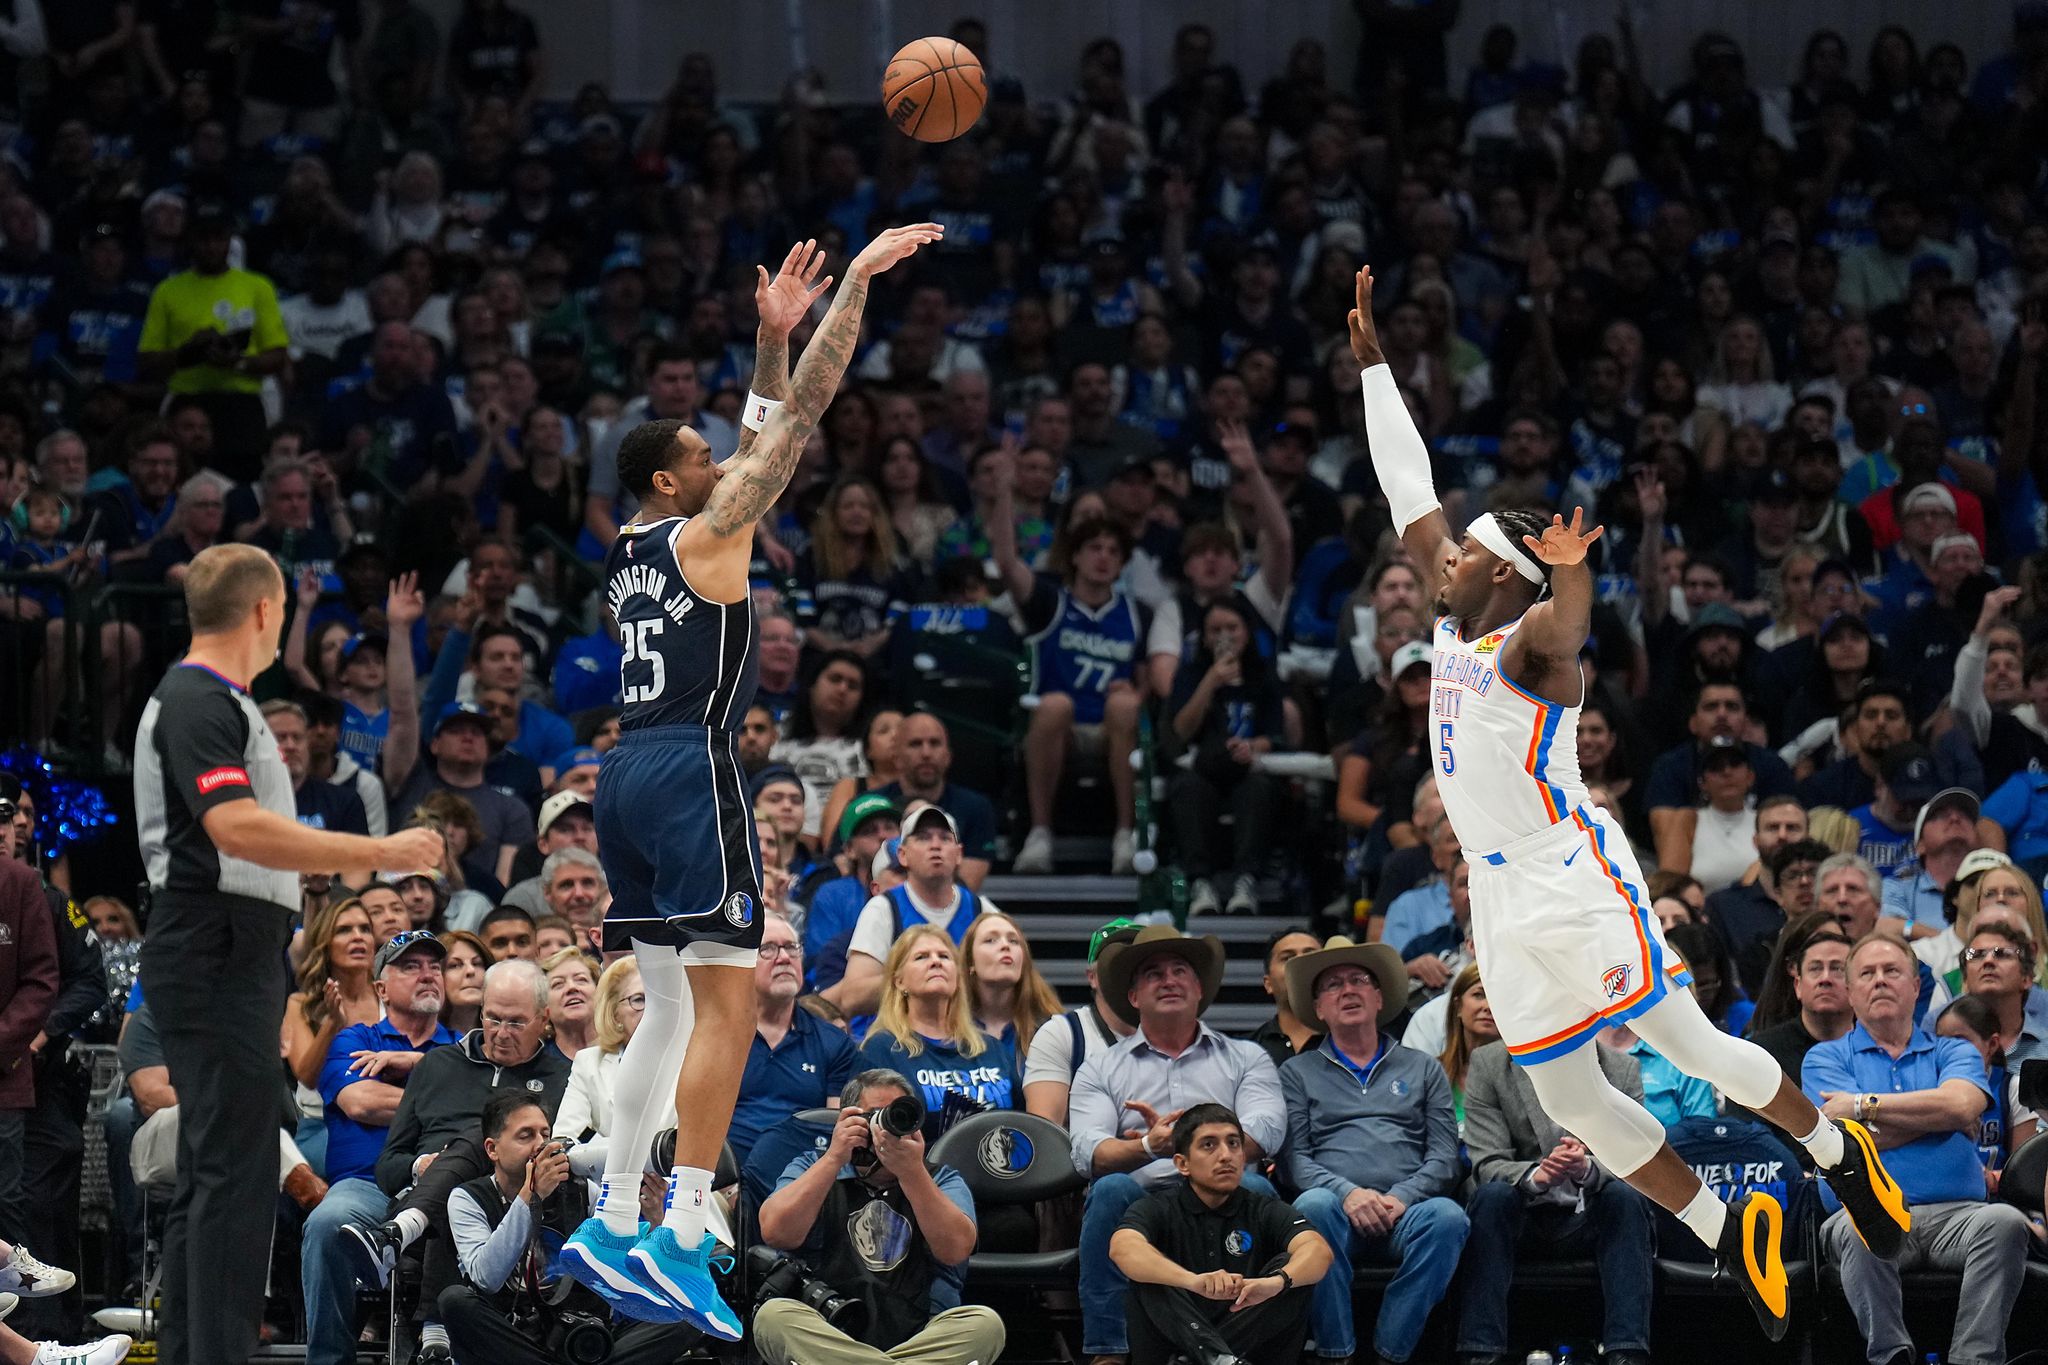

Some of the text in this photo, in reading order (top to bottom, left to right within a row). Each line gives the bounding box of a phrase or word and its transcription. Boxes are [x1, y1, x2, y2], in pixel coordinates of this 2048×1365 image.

[664, 591, 694, 626] JR.
[620, 618, 665, 704] 25
[1073, 655, 1116, 692] 77
[1434, 686, 1463, 718] CITY
[1439, 720, 1456, 777] 5
[202, 771, 243, 788] Emirates
[916, 1068, 955, 1087] ONE
[1743, 1160, 1783, 1185] FOR
